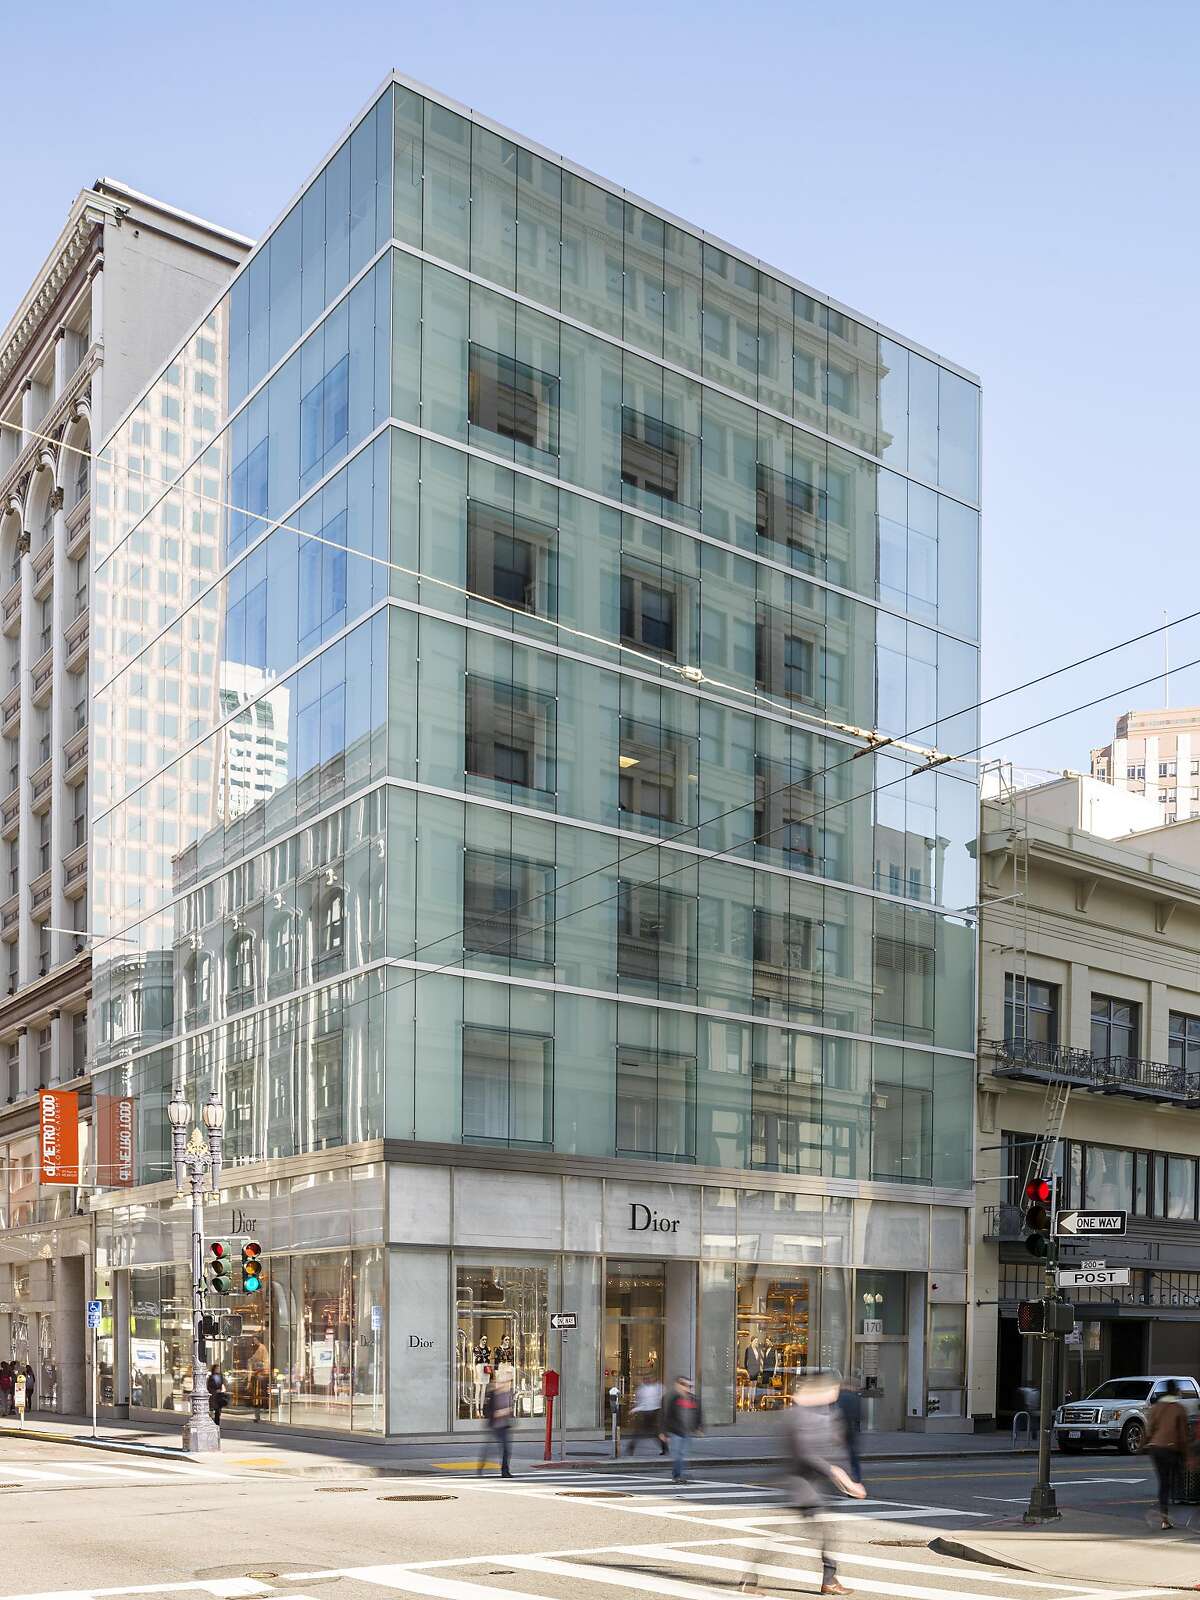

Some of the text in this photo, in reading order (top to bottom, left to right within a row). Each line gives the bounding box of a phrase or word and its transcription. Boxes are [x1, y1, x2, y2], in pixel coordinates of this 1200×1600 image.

[230, 1208, 257, 1234] Dior
[628, 1203, 680, 1232] Dior
[1076, 1218, 1119, 1228] ONE WAY
[1083, 1260, 1097, 1268] 200
[1074, 1272, 1116, 1284] POST
[865, 1322, 881, 1333] 170
[408, 1335, 434, 1348] Dior
